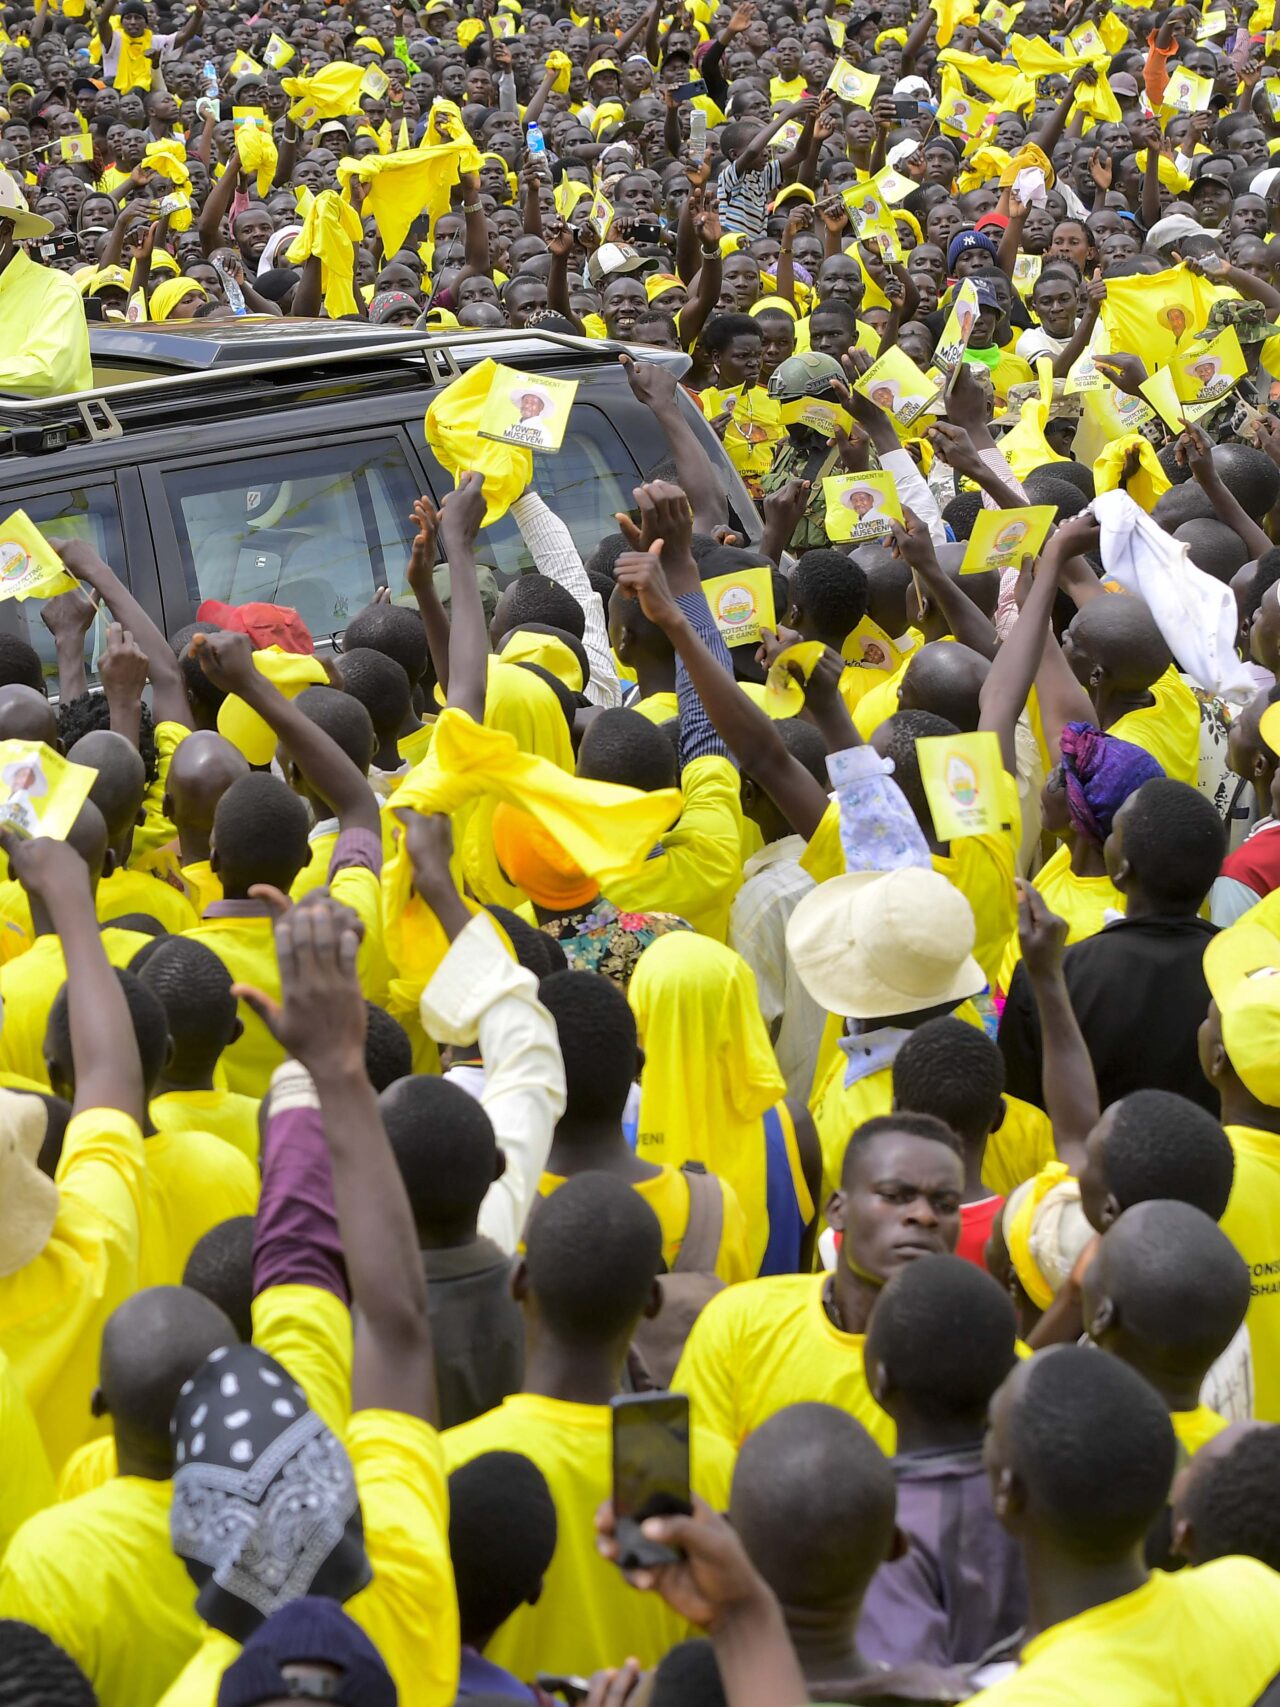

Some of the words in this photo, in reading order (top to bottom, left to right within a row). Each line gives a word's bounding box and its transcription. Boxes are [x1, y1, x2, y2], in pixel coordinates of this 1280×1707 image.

[528, 377, 560, 388] PRESIDENT
[511, 424, 542, 437] YOWERI
[503, 430, 544, 445] MUSEVENI
[846, 473, 877, 482] PRESIDENT
[853, 518, 884, 530] YOWERI
[850, 524, 890, 537] MUSEVENI
[721, 622, 760, 635] ROTECTING
[736, 629, 757, 640] GAINS
